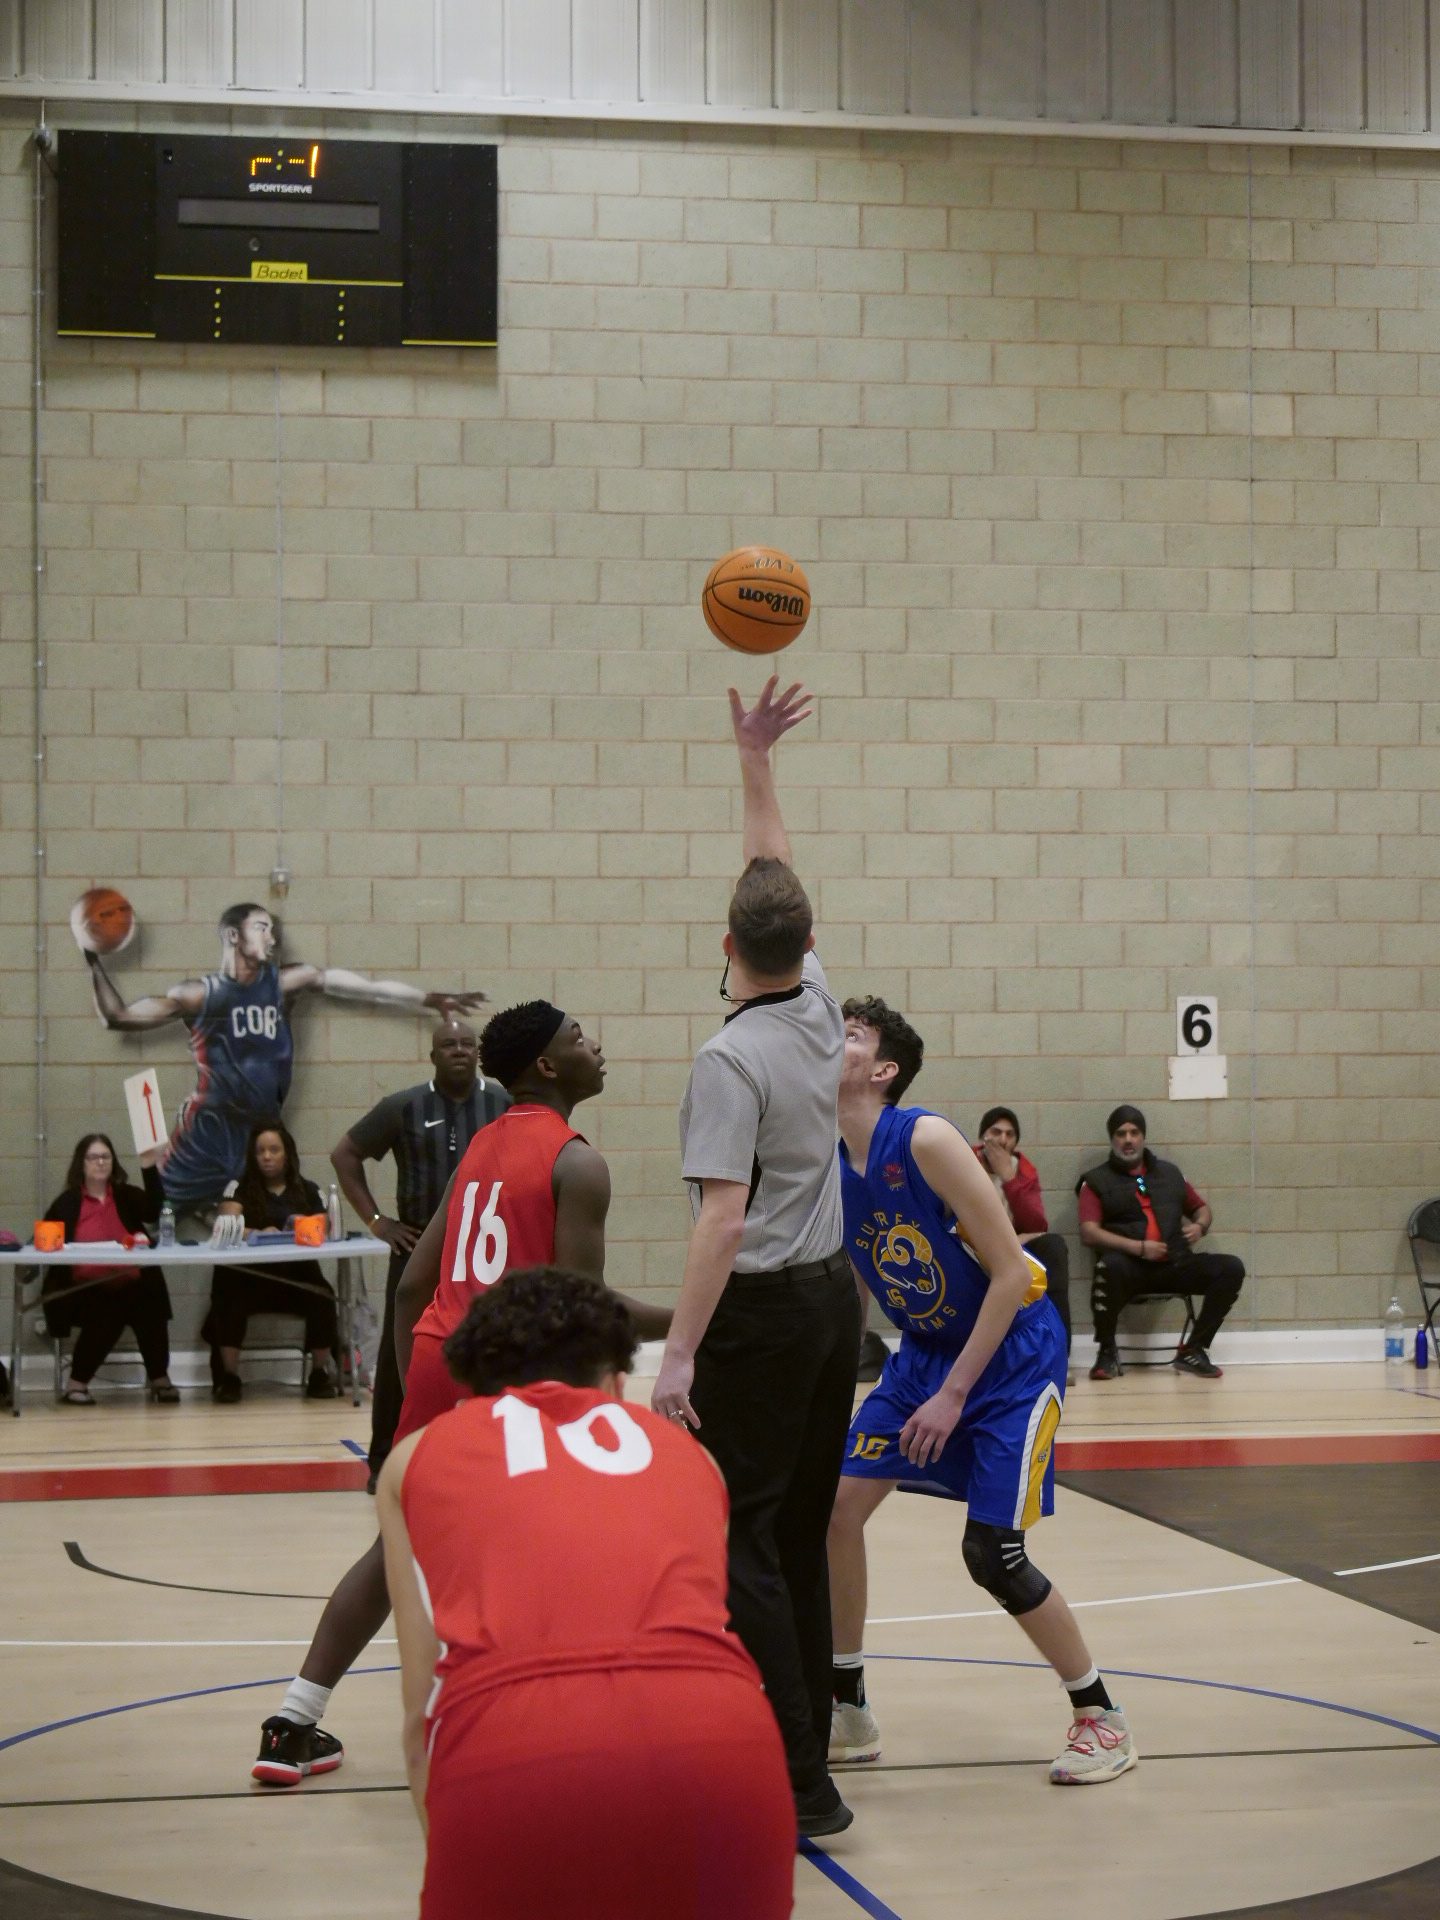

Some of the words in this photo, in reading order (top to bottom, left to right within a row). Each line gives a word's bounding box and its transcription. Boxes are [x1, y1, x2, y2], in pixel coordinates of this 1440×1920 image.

[248, 182, 313, 195] SPORTSERVE
[256, 264, 304, 280] Bodet
[738, 587, 804, 618] Wilson
[1182, 1003, 1212, 1049] 6
[452, 1181, 509, 1285] 16
[491, 1394, 654, 1478] 10
